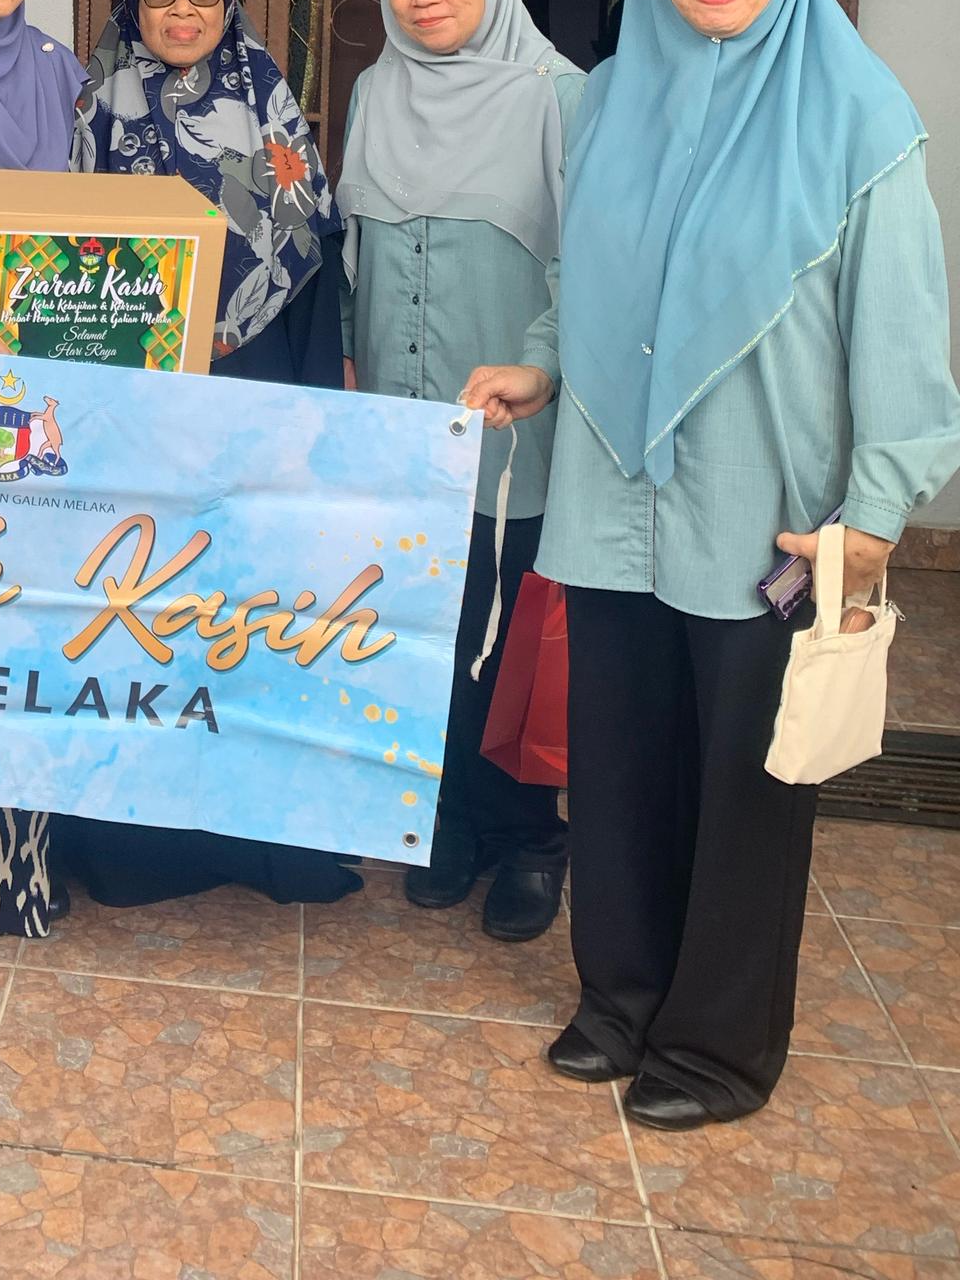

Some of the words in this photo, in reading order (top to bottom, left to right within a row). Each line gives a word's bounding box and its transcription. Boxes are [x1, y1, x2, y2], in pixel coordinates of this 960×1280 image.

[9, 267, 95, 299] Ziarah
[100, 265, 168, 303] Kasih
[31, 298, 55, 313] Kelab
[57, 298, 98, 313] Kebajikan
[100, 301, 108, 311] &
[110, 300, 147, 313] Rekreasi
[74, 311, 98, 324] Tanah
[100, 314, 108, 323] &
[110, 312, 139, 329] Galian
[63, 326, 108, 341] Selamat
[48, 342, 83, 358] Hari
[84, 342, 117, 360] Raya
[12, 494, 60, 508] GALIAN
[63, 499, 116, 514] MELAKA
[62, 514, 397, 672] Kasih
